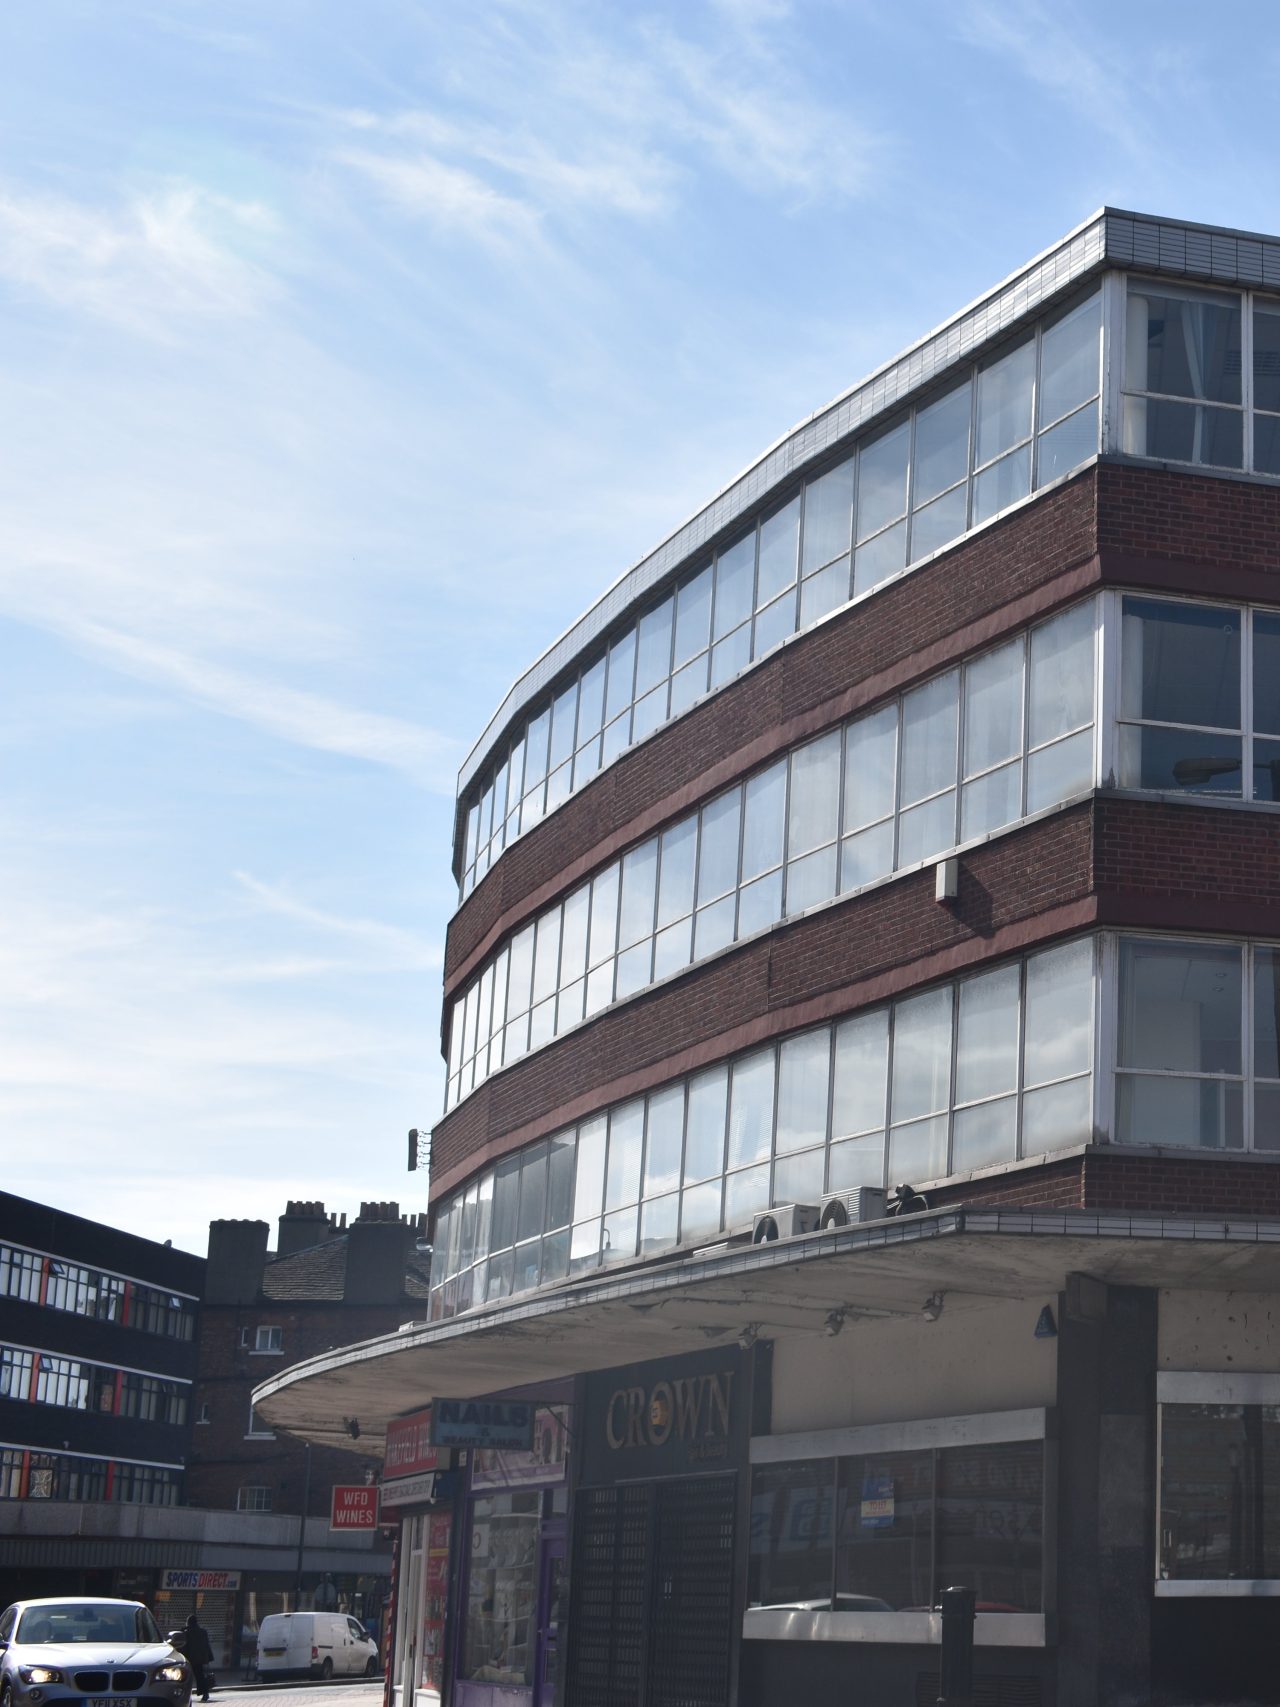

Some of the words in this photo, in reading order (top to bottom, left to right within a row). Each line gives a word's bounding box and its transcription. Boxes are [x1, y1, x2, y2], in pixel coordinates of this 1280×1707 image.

[440, 1402, 529, 1427] NAILS
[606, 1371, 736, 1450] CROWN
[443, 1436, 484, 1446] BEAUTY
[343, 1491, 369, 1506] WFD
[336, 1508, 373, 1524] WINES
[166, 1571, 198, 1588] SPORTS
